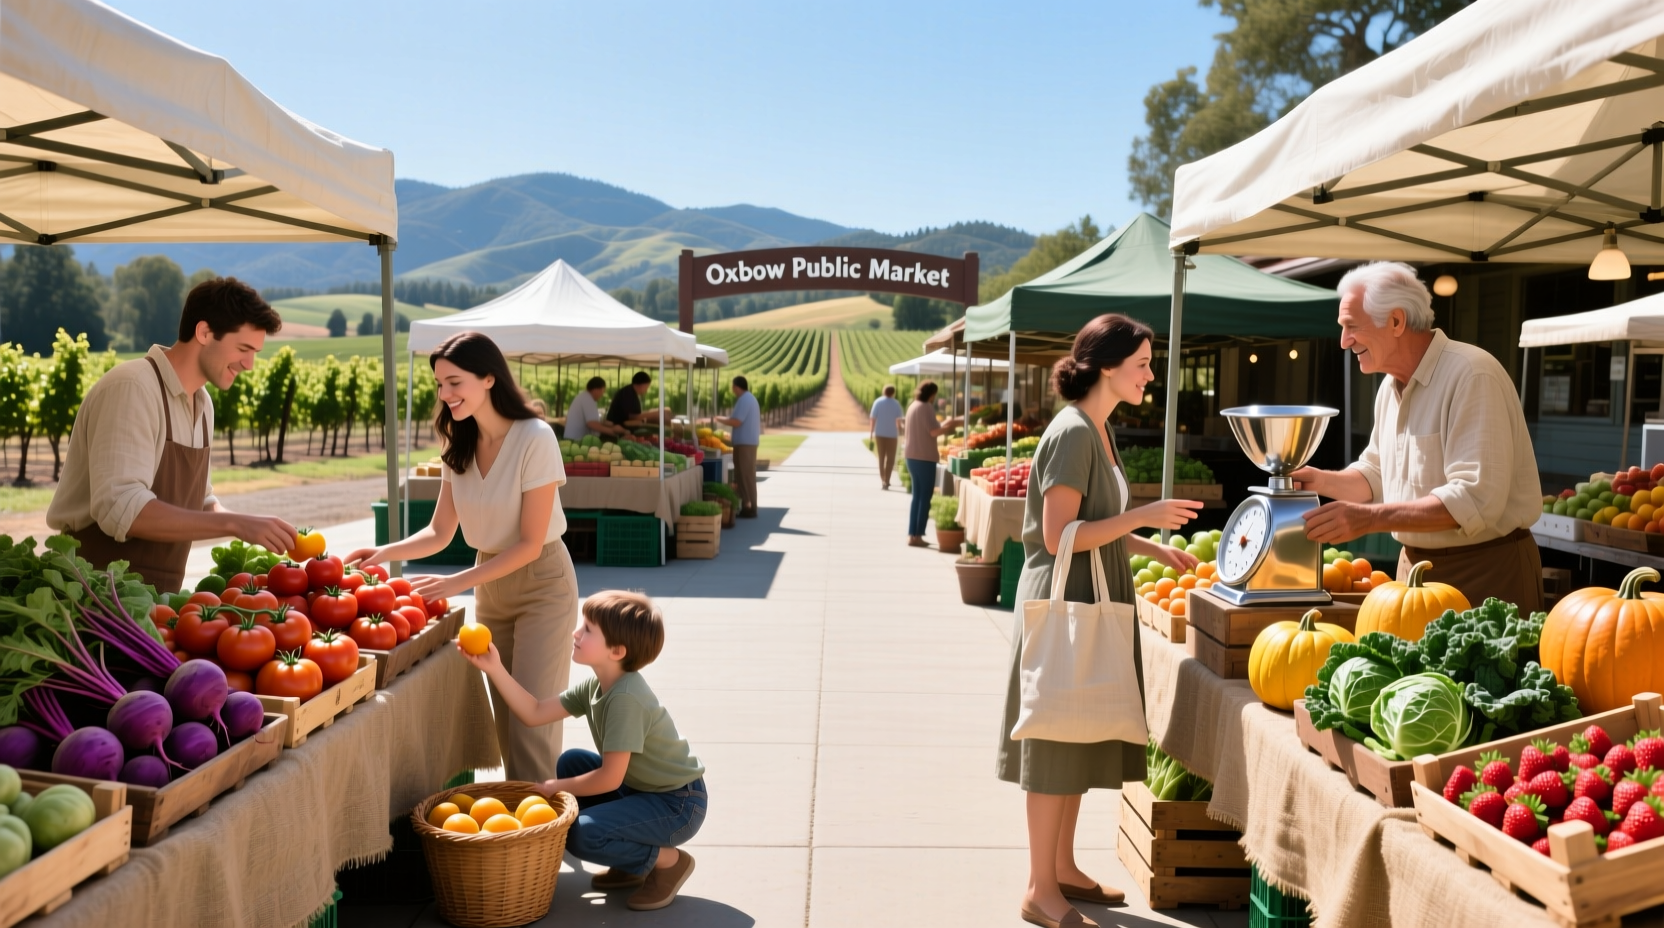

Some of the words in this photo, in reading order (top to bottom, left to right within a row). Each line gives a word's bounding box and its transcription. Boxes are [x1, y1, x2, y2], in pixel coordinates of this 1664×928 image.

[705, 260, 786, 285] Oxbow
[792, 256, 862, 279] Public
[868, 257, 950, 288] Market
